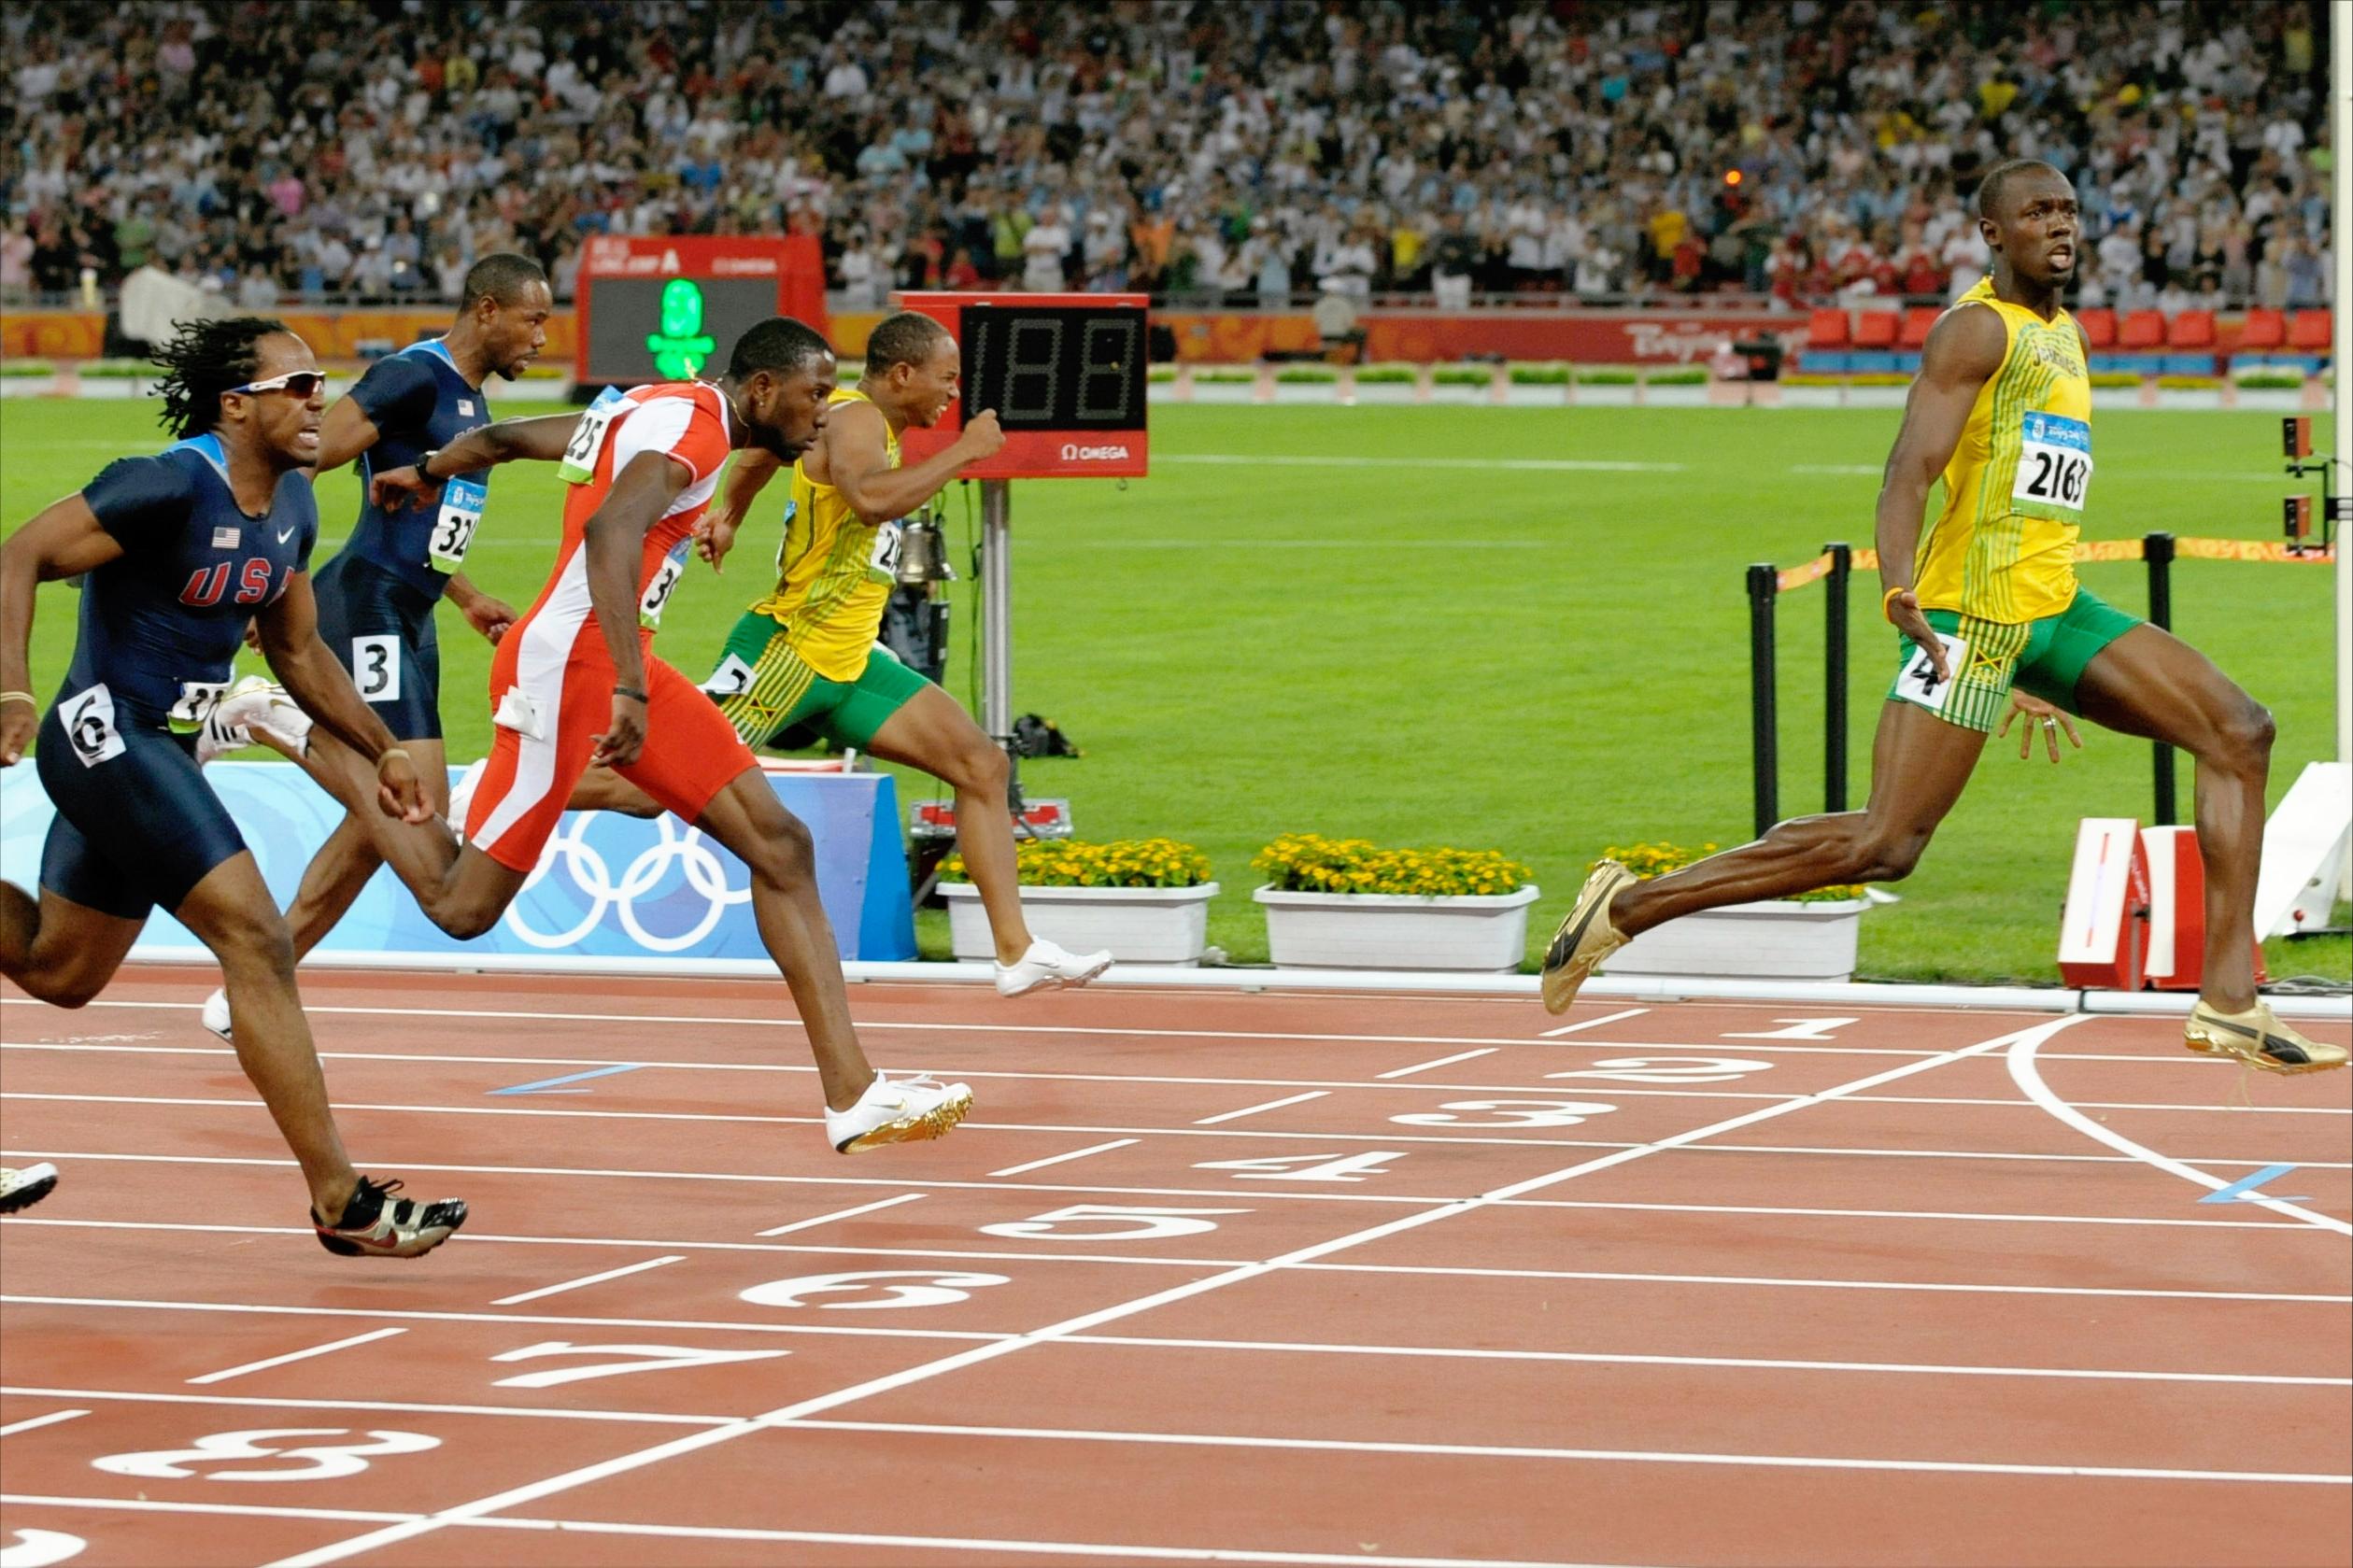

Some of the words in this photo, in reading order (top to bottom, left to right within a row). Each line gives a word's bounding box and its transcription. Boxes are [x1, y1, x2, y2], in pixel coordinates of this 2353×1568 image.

[566, 416, 603, 461] 25
[1079, 446, 1128, 460] OMEGA
[2026, 451, 2088, 503] 2163
[437, 516, 478, 558] 32
[646, 568, 681, 610] 3
[362, 643, 389, 695] 3
[71, 694, 107, 758] 6
[1720, 1017, 1861, 1040] 1
[1543, 1056, 1775, 1083] 2
[1388, 1099, 1619, 1127] 3
[1190, 1151, 1410, 1182] 4
[977, 1205, 1255, 1240] 5
[738, 1270, 1012, 1309] 6
[489, 1340, 794, 1389] 7
[90, 1428, 444, 1482] 8
